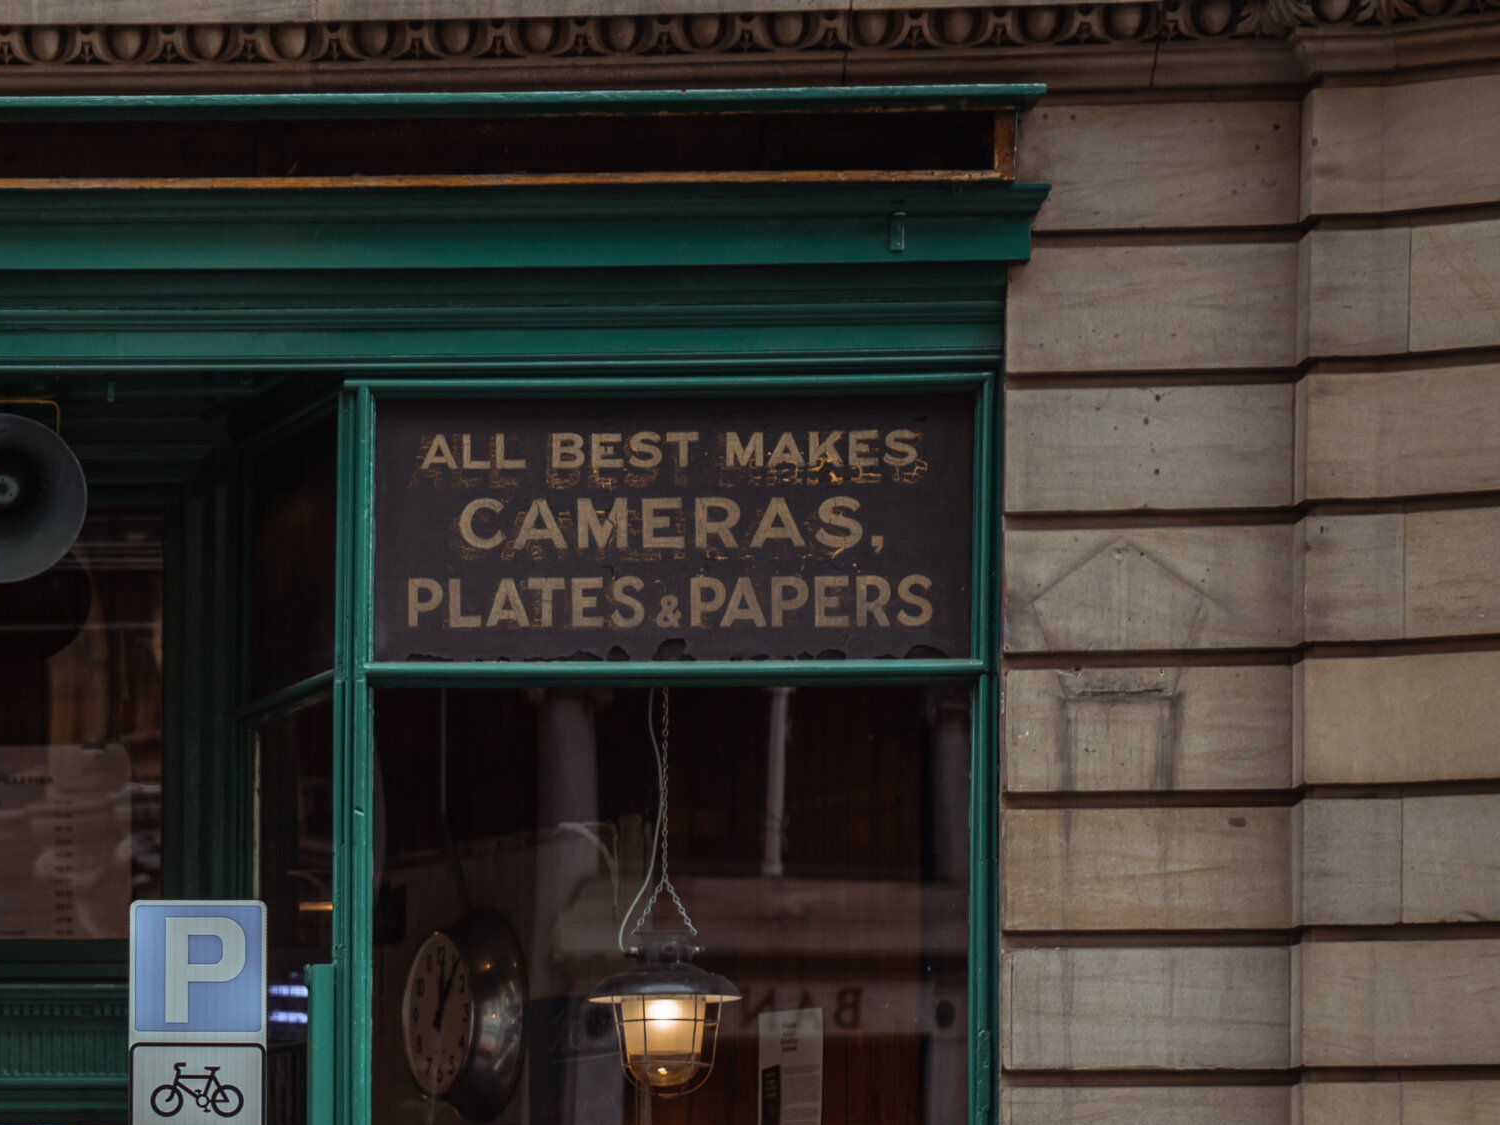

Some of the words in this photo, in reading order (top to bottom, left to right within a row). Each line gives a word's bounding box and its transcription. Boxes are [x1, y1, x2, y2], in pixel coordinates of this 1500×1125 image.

[419, 432, 527, 471] ALL
[550, 431, 699, 470] BEST
[724, 428, 919, 468] MAKES
[458, 495, 885, 555] CAMERAS,
[165, 917, 246, 1023] P
[416, 978, 424, 998] 10
[459, 974, 465, 994] 2
[412, 1007, 419, 1026] 9
[463, 1003, 469, 1023] 3
[416, 1035, 422, 1055] 8
[458, 1034, 465, 1051] 4
[425, 1056, 432, 1076] 7
[436, 1064, 442, 1083] 6
[448, 1055, 455, 1076] 5
